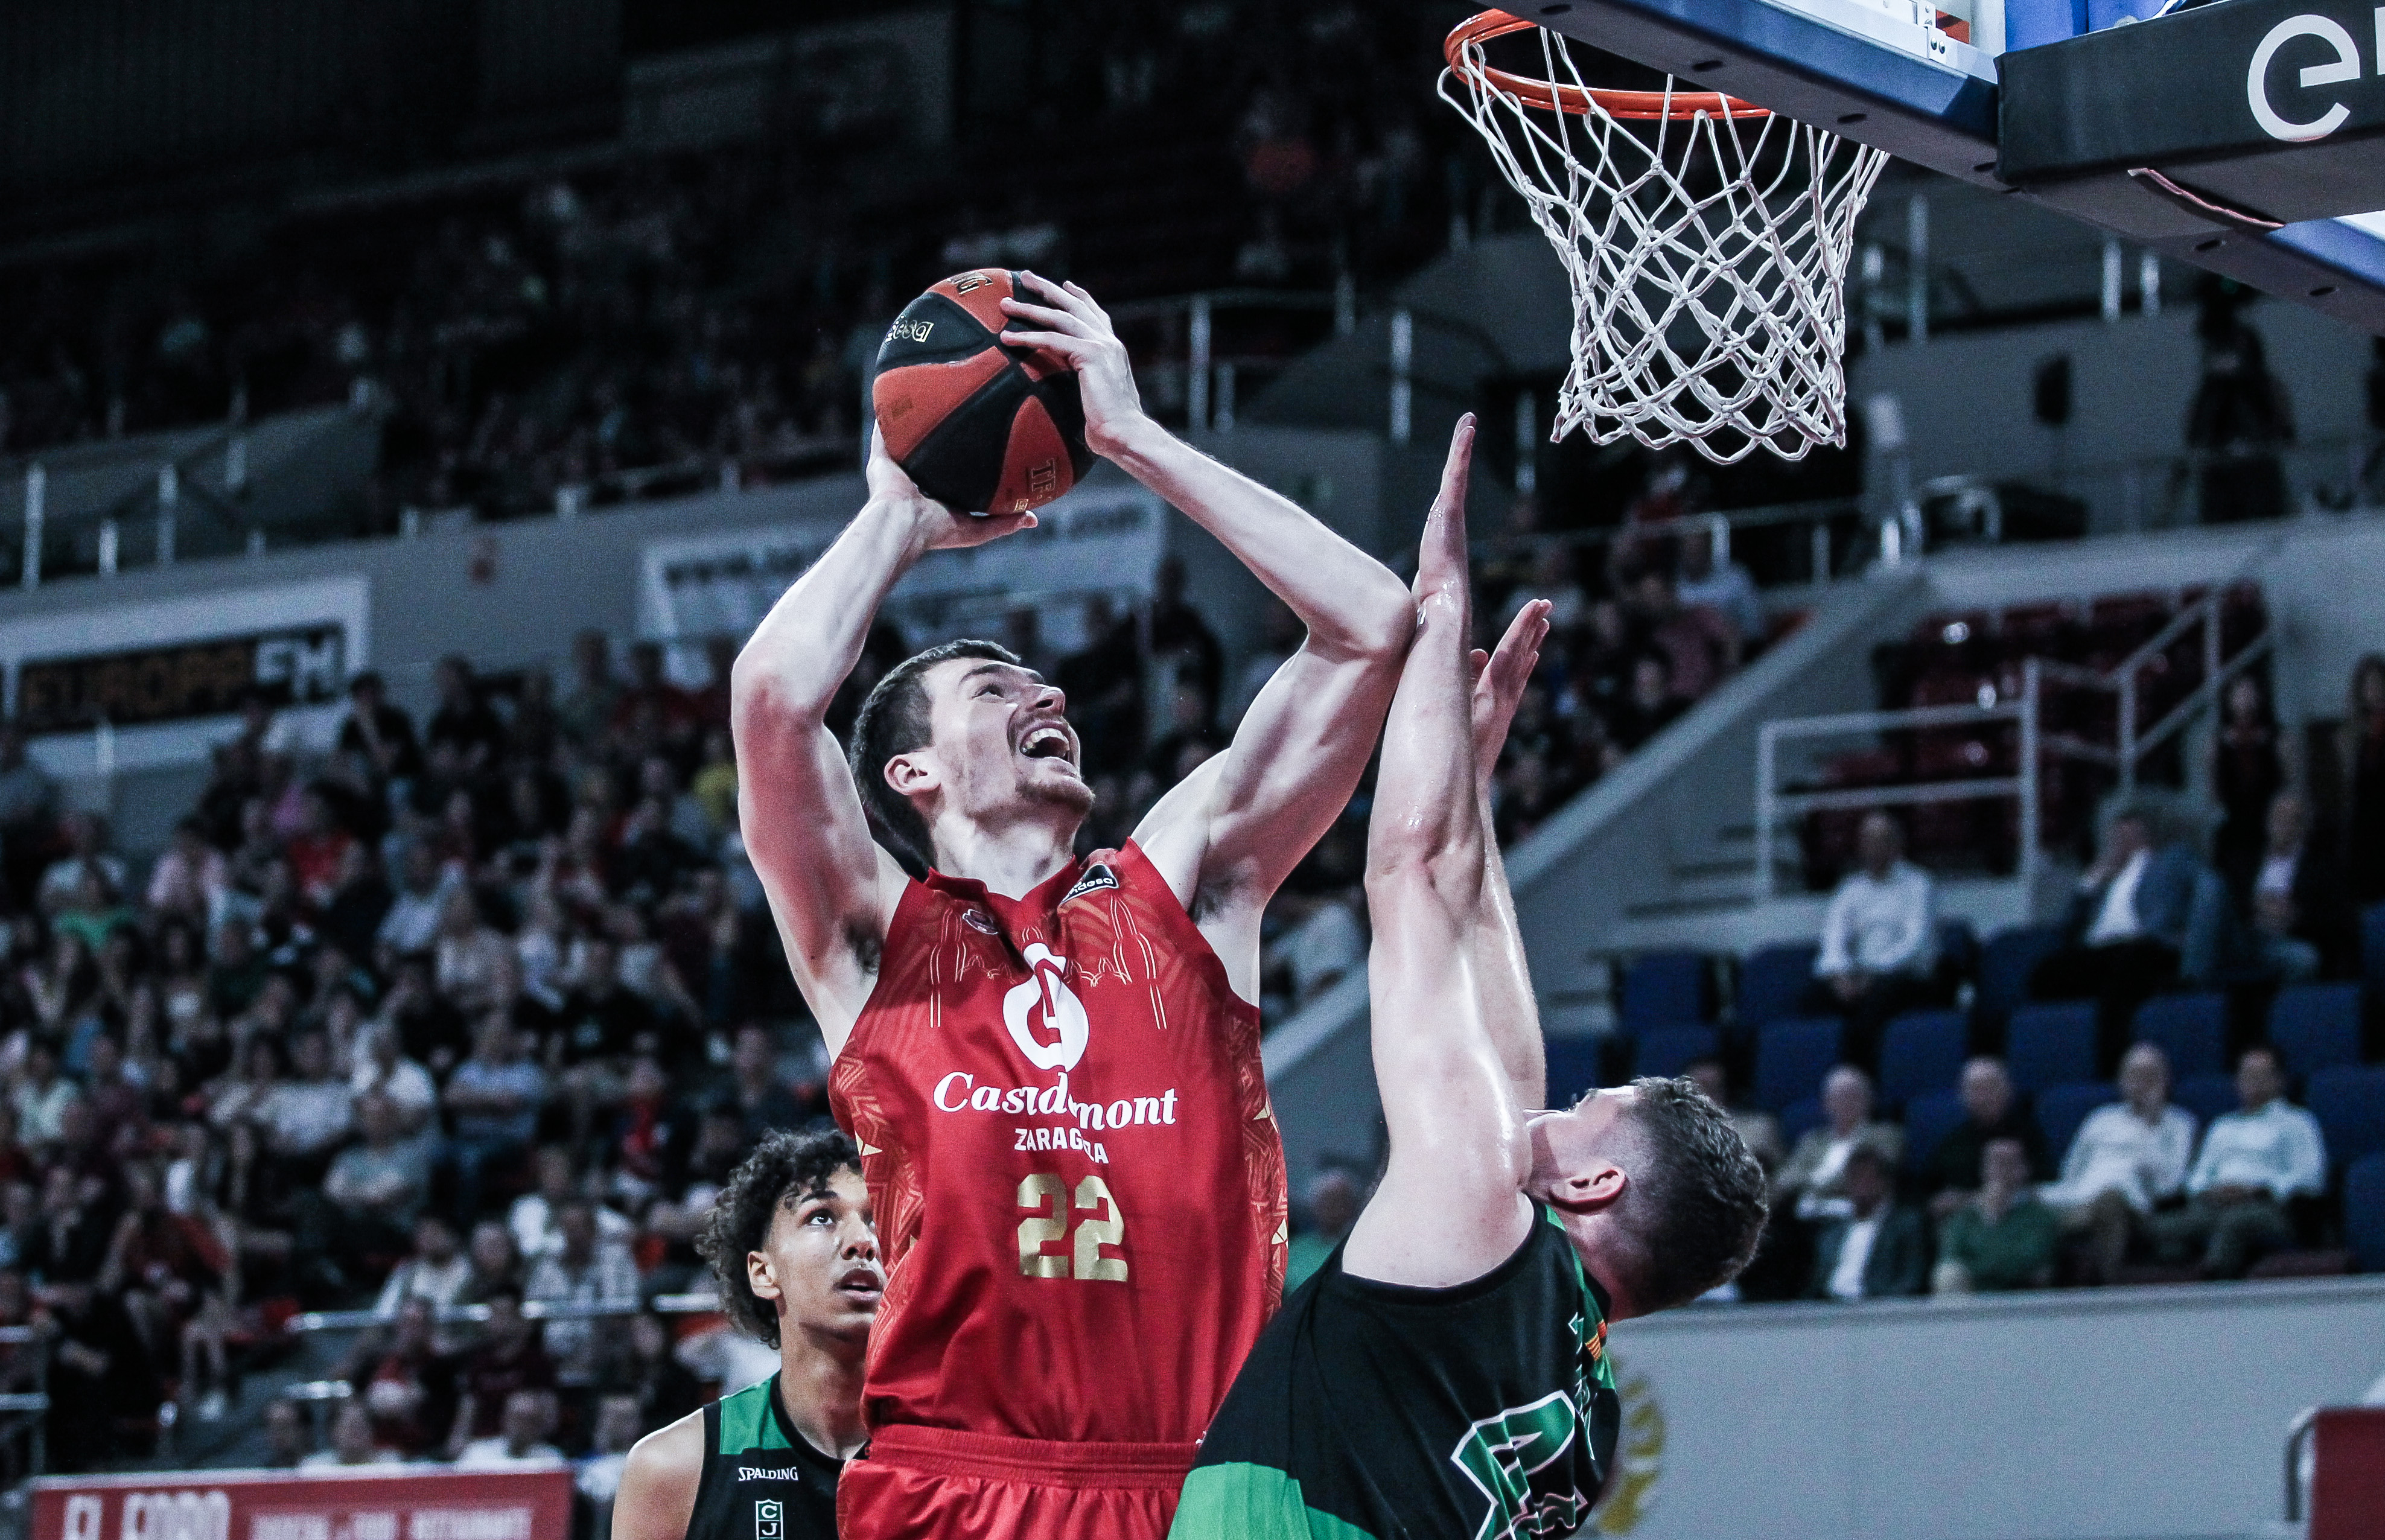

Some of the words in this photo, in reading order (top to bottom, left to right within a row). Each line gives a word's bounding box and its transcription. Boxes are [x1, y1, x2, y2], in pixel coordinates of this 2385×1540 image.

[933, 1071, 1179, 1130] Casdmont
[1014, 1126, 1109, 1164] ZARAGA
[1017, 1172, 1129, 1282] 22
[738, 1466, 799, 1481] SPALDING
